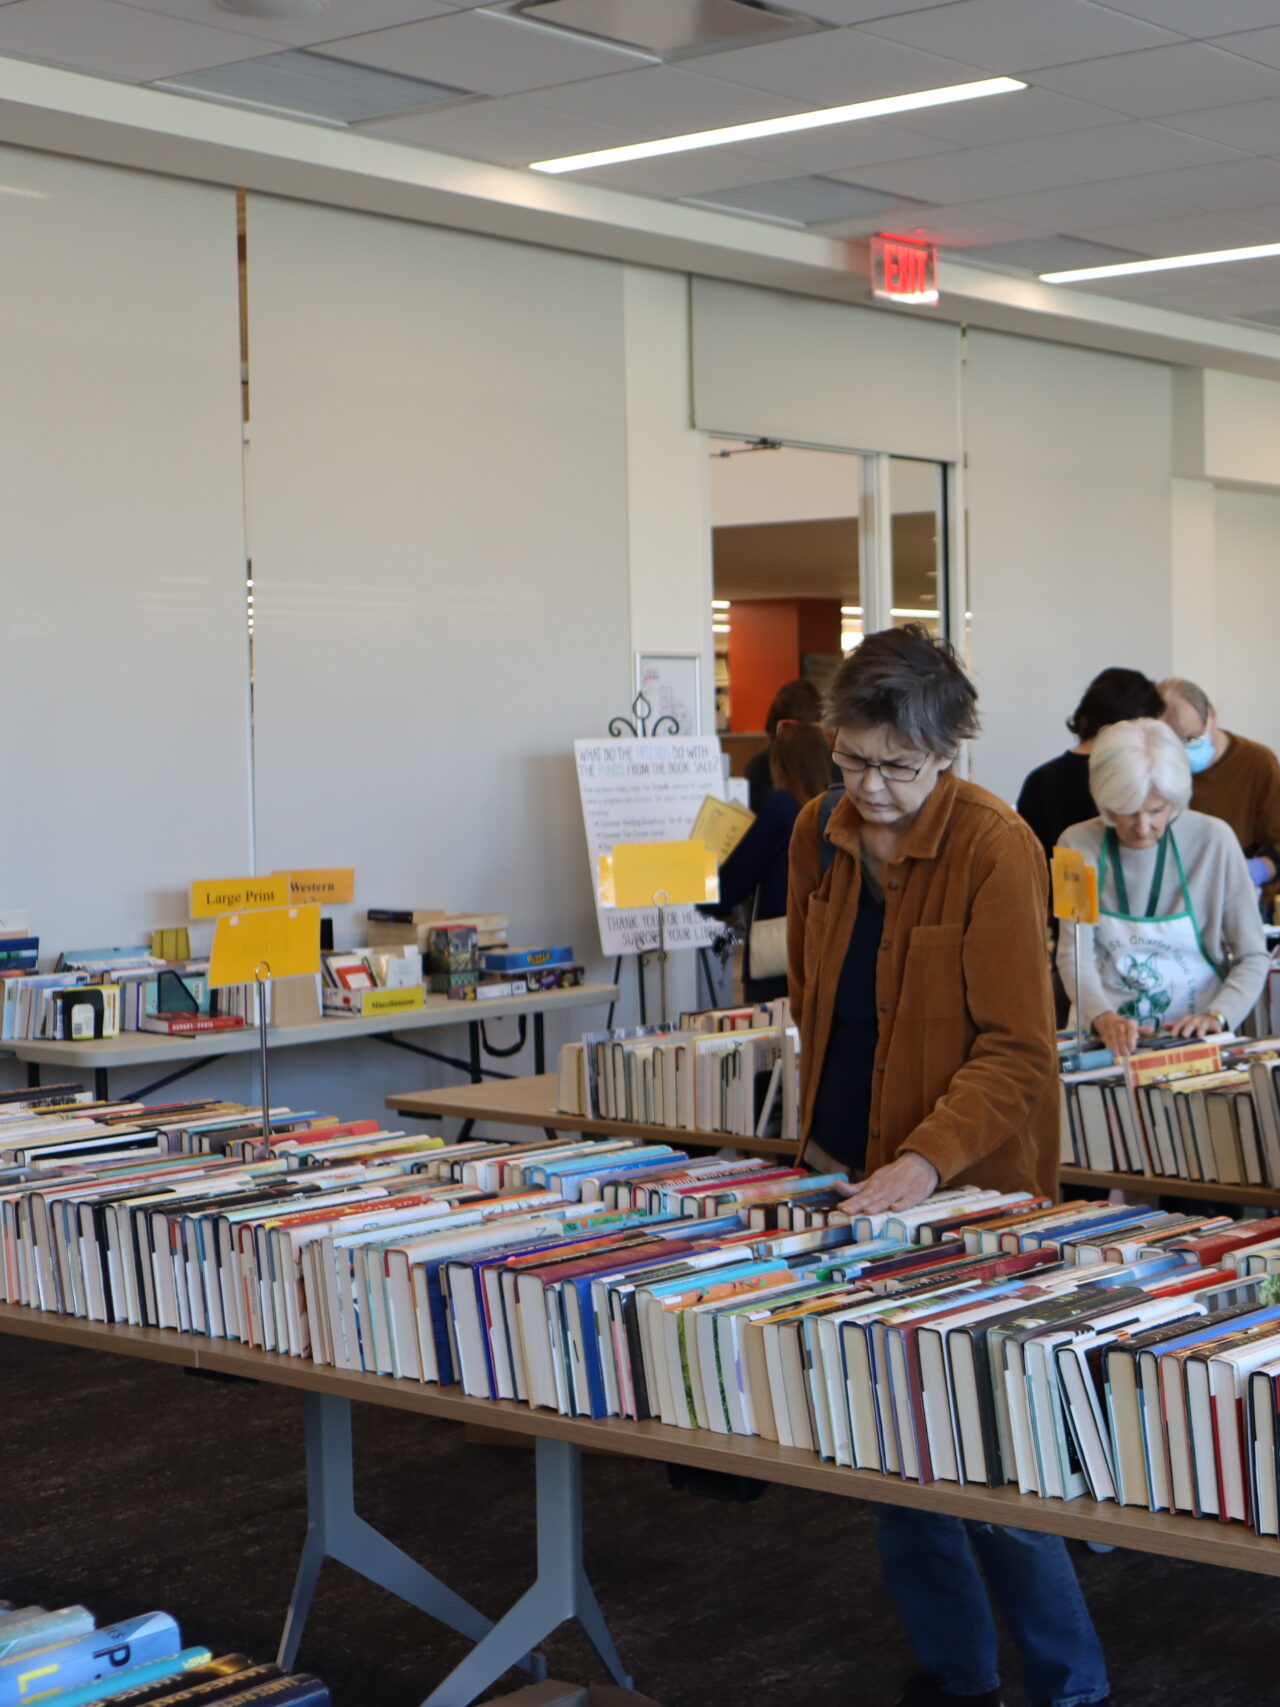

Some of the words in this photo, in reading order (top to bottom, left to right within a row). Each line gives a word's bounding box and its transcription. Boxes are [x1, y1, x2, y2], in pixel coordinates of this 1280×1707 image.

[885, 244, 928, 293] EXIT
[290, 881, 334, 893] Western
[206, 892, 241, 907] Large
[246, 890, 275, 903] Print
